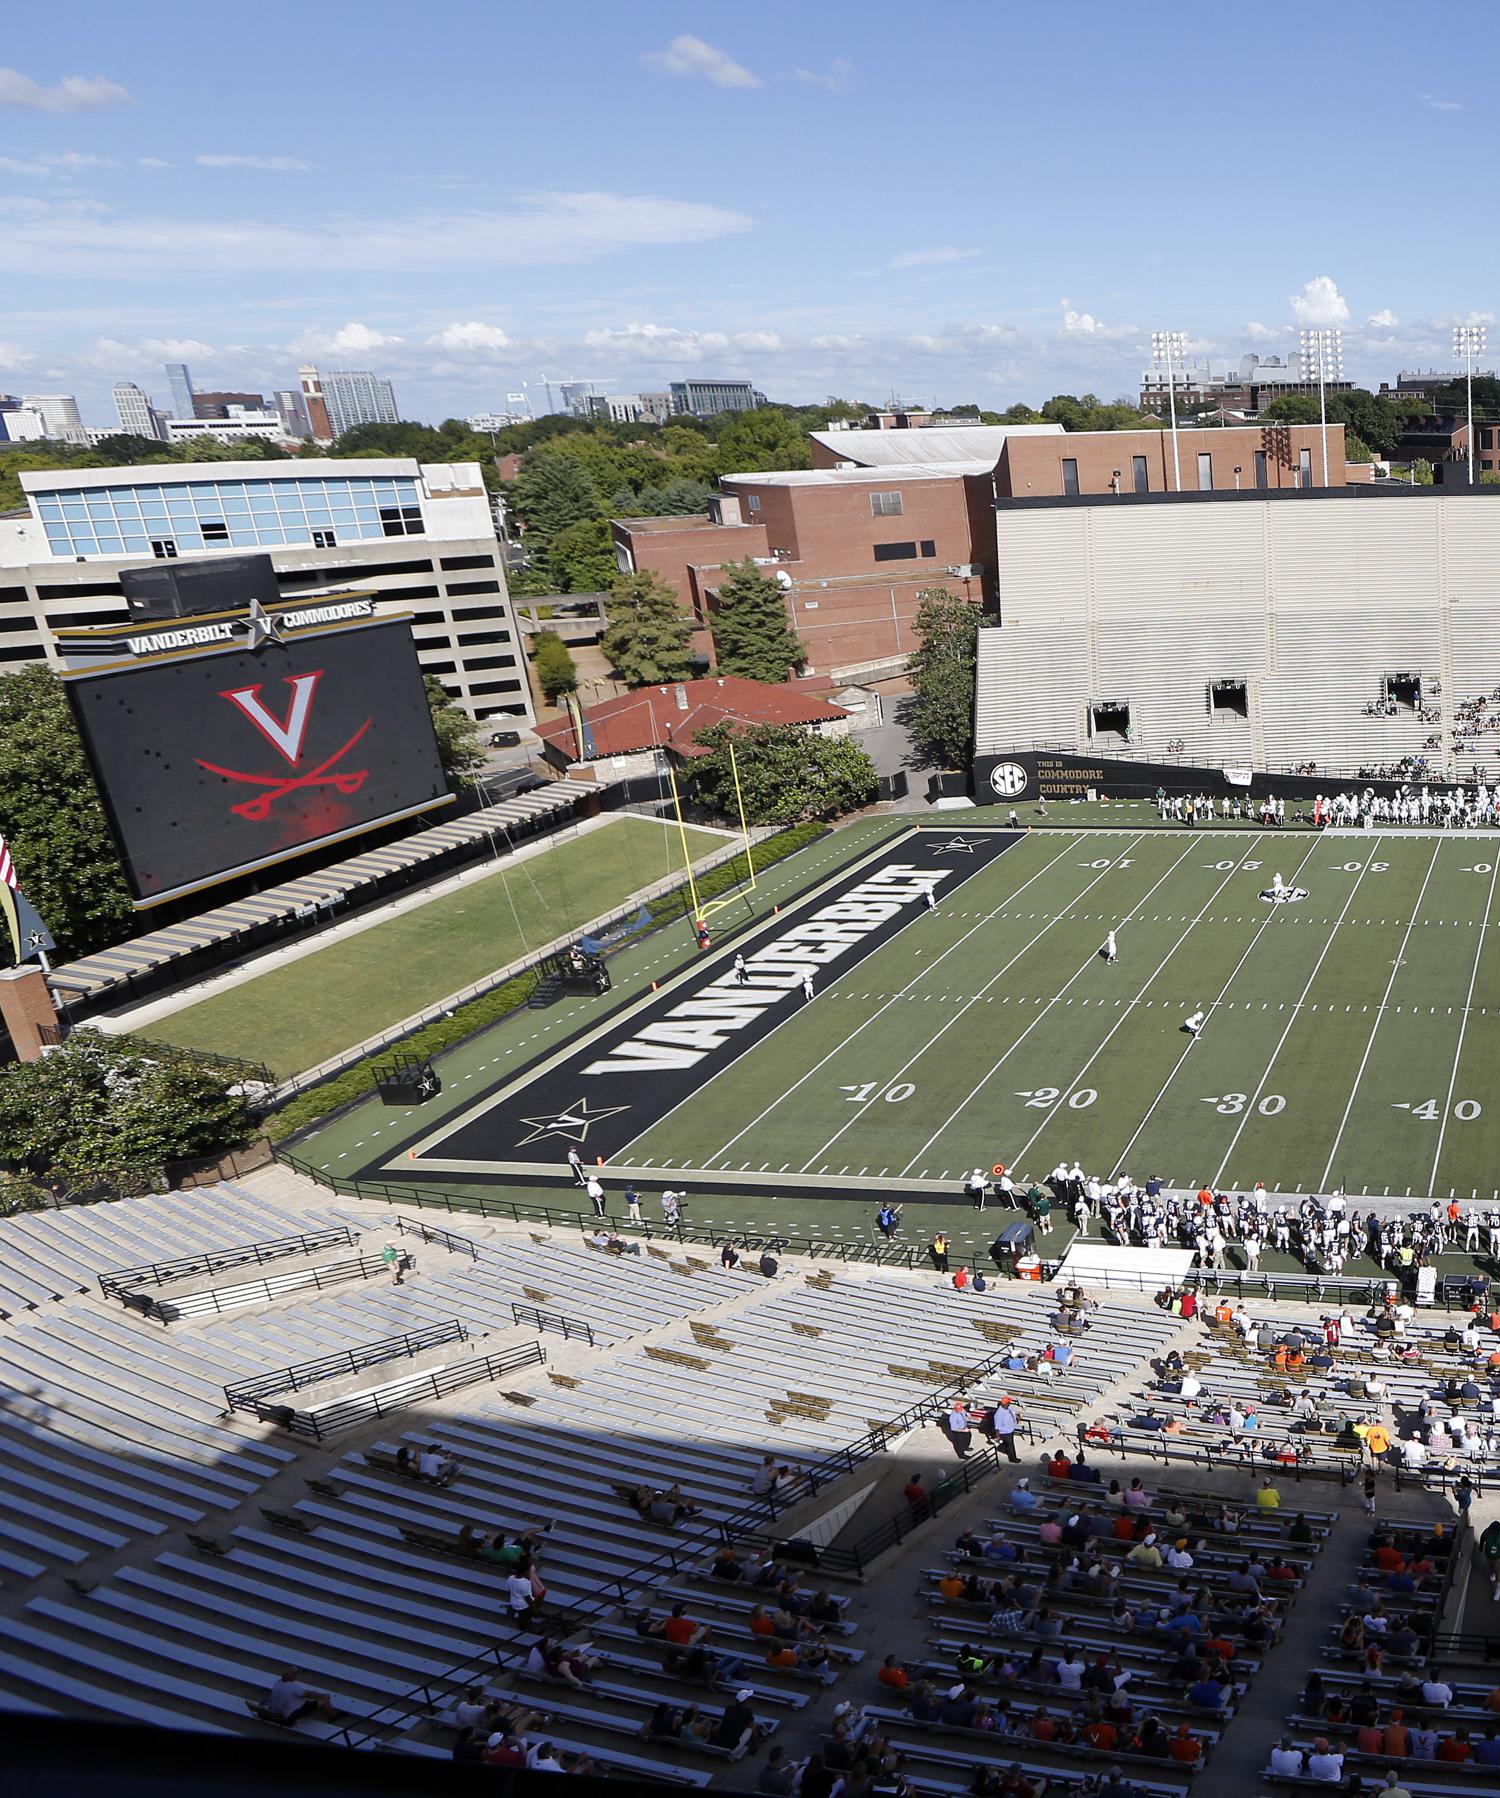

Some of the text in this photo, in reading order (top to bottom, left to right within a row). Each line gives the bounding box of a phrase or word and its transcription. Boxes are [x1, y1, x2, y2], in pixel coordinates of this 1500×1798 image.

[127, 600, 372, 654] VANDERBILT V COMMODORES
[217, 669, 325, 768] V
[992, 764, 1025, 794] SEC
[1038, 770, 1104, 780] COMMODORE
[1040, 784, 1090, 794] COUNTRY
[1090, 858, 1135, 869] 10
[1216, 860, 1264, 871] 20
[1342, 861, 1390, 872] 30
[579, 864, 953, 1075] VANDERBILT
[861, 1081, 916, 1103] 10
[1024, 1087, 1098, 1110] 20
[1216, 1093, 1287, 1116] 30
[1411, 1099, 1482, 1121] 40
